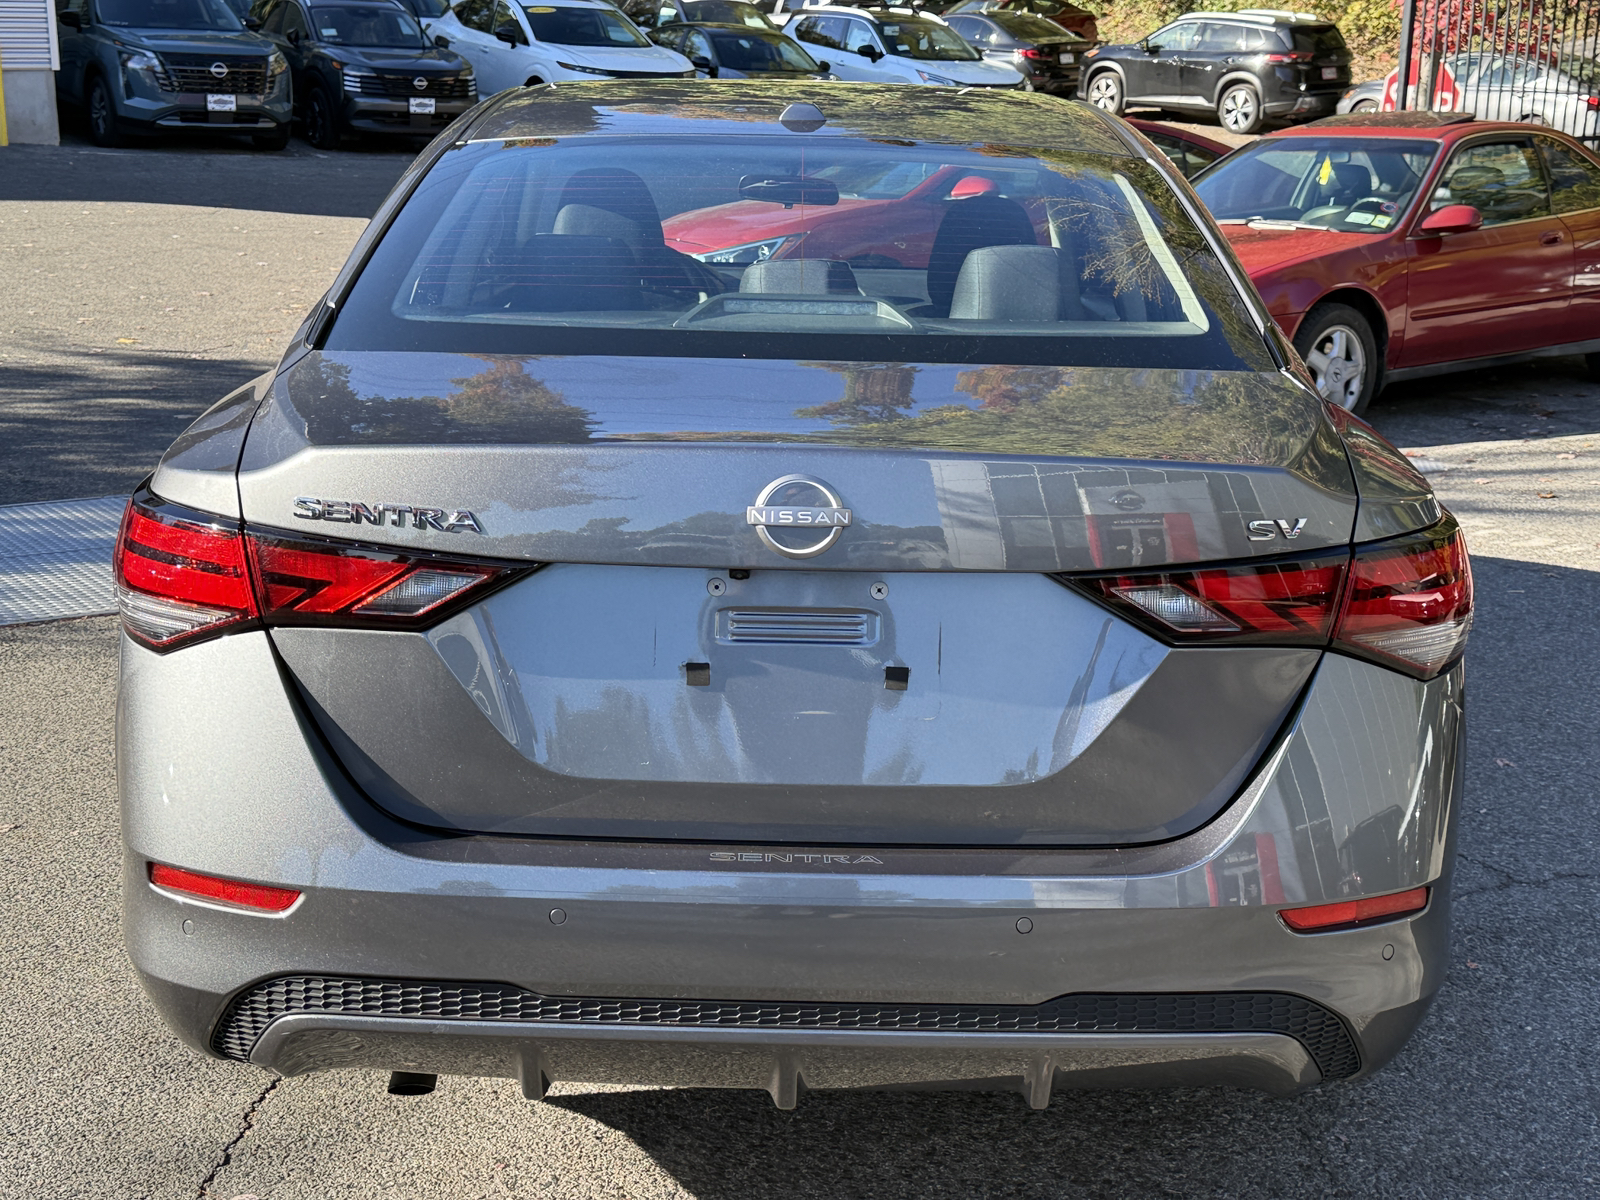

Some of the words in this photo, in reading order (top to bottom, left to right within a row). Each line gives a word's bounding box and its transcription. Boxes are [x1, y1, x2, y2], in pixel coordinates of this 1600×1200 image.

[293, 496, 482, 533] SENTRA
[750, 509, 849, 524] NISSAN
[1247, 518, 1308, 541] SV
[709, 851, 884, 865] SENTRA
